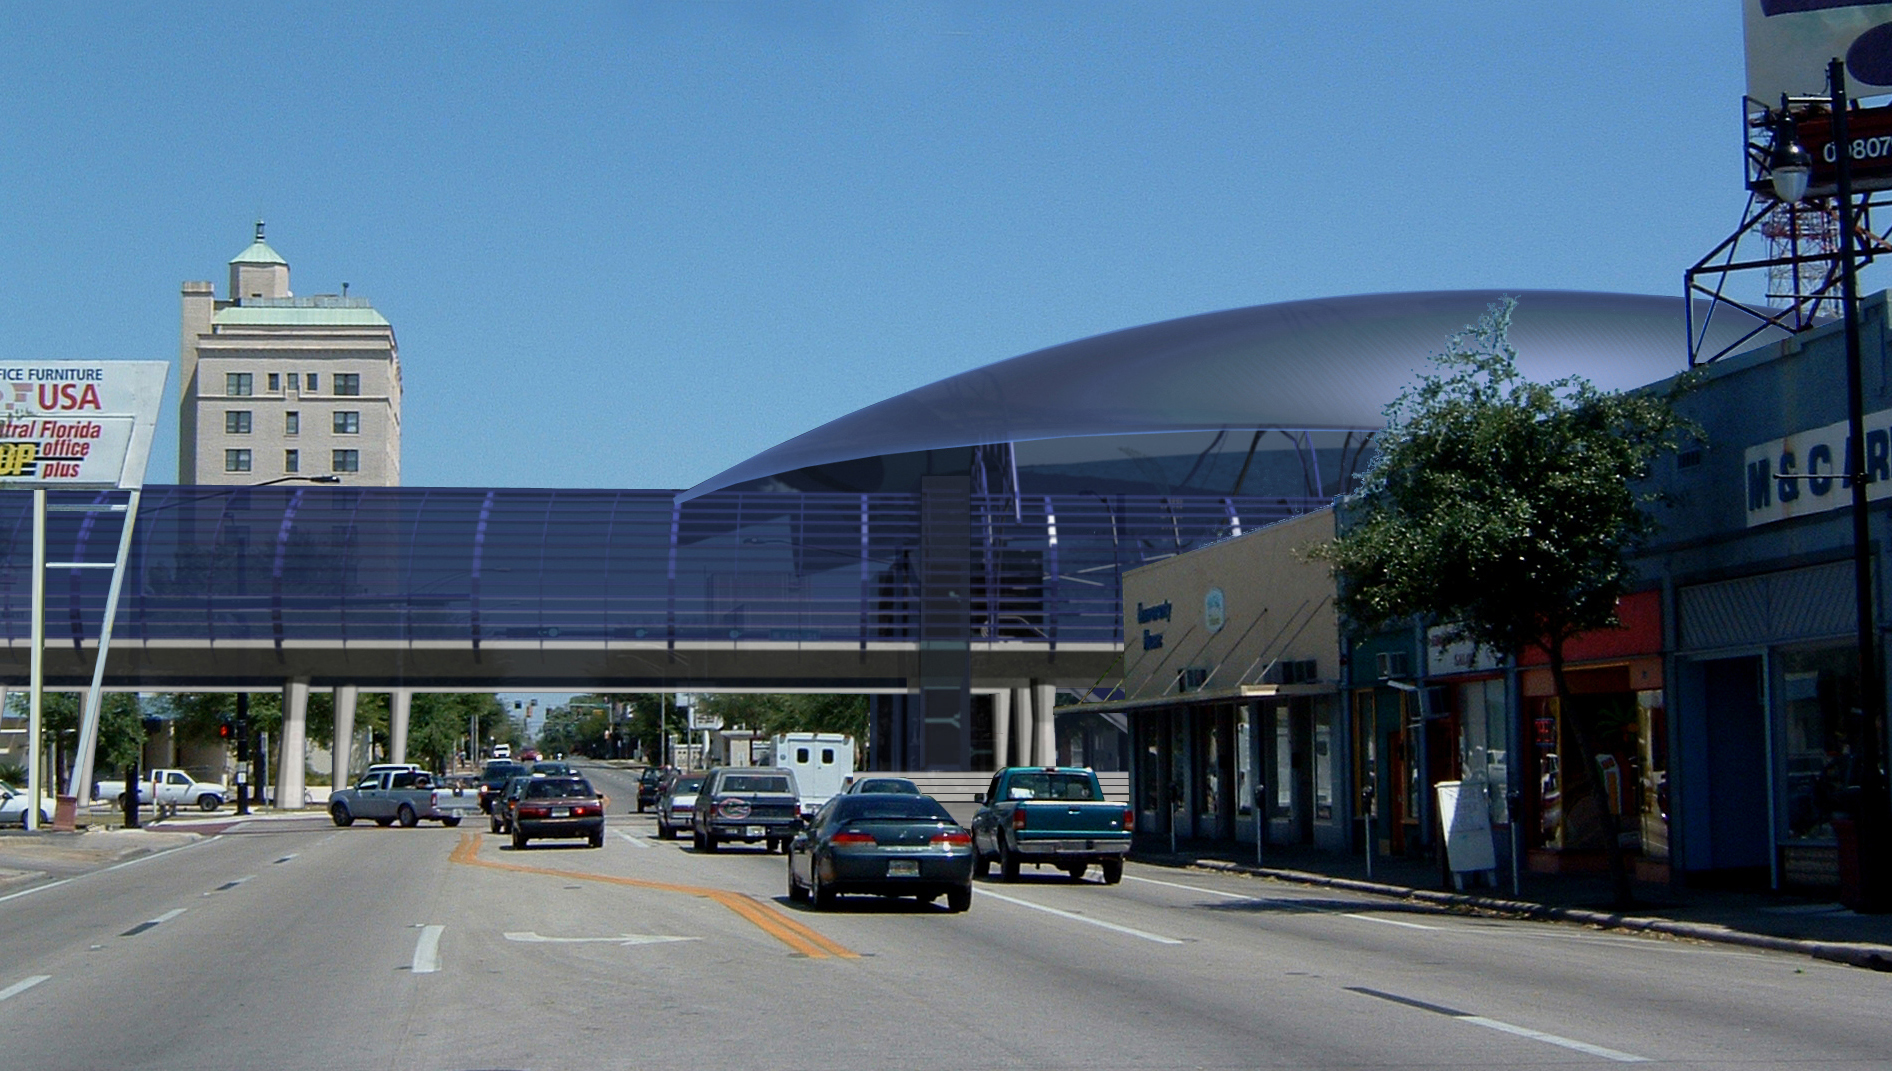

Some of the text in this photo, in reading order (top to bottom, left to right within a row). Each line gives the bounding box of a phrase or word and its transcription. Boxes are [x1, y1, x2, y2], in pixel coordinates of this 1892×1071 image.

[28, 369, 102, 380] FURNITURE
[38, 383, 101, 410] USA
[40, 420, 102, 439] Florida
[43, 438, 90, 457] office
[42, 461, 80, 479] plus
